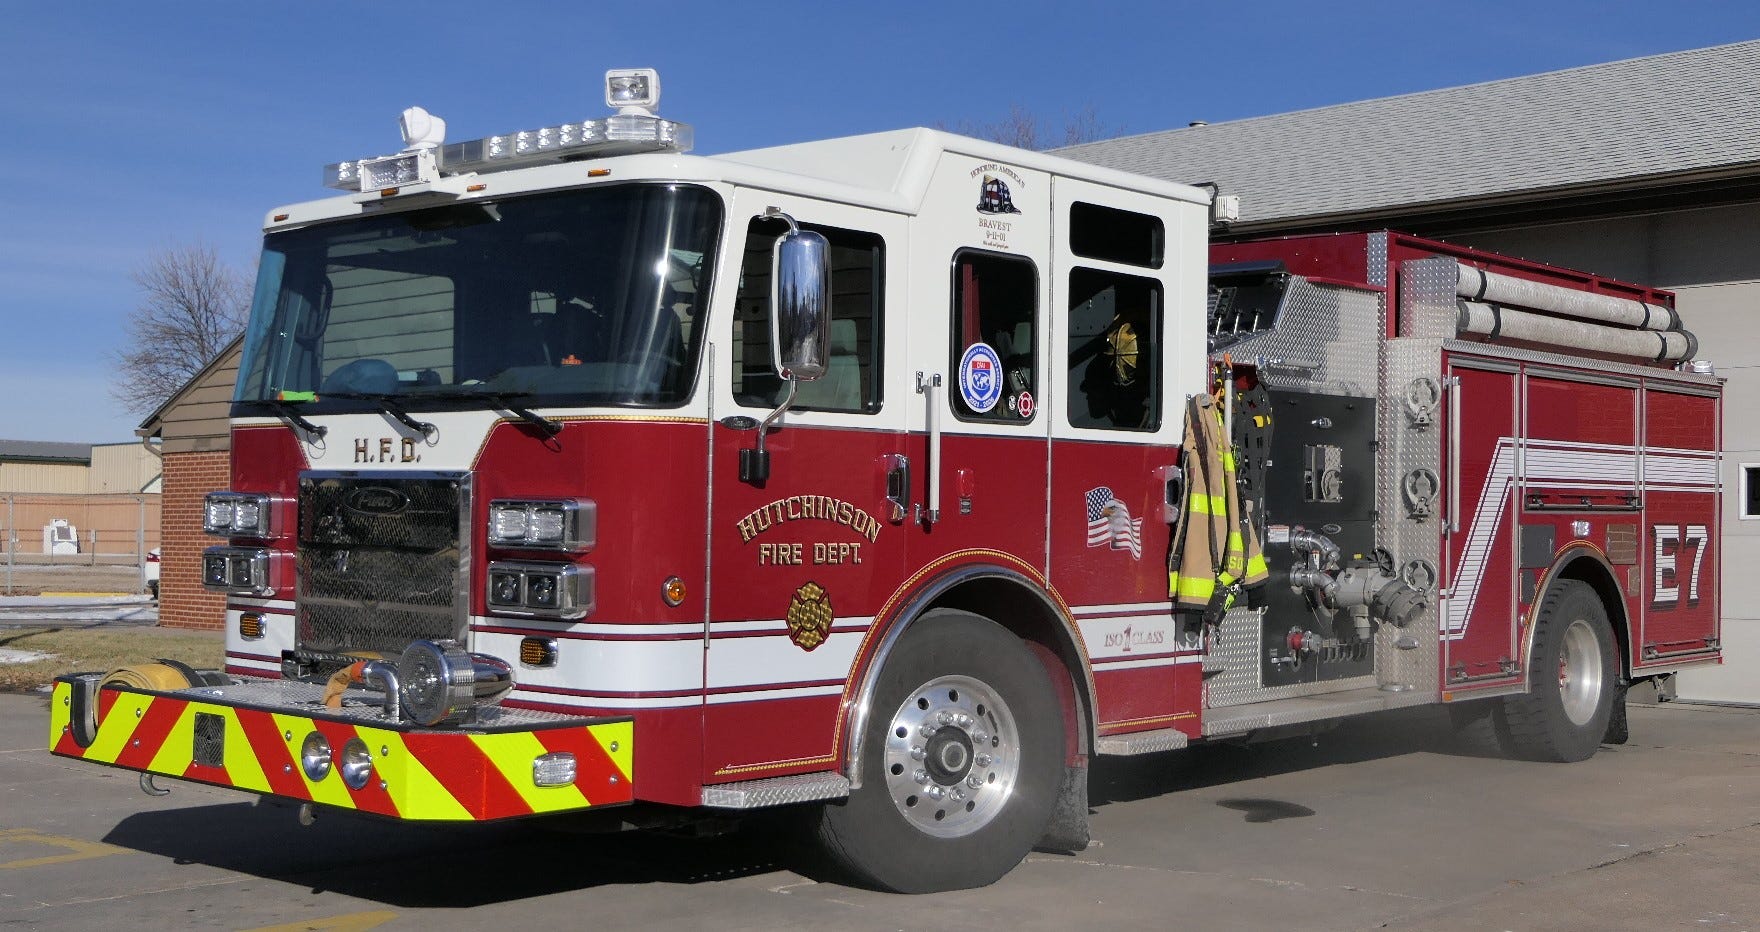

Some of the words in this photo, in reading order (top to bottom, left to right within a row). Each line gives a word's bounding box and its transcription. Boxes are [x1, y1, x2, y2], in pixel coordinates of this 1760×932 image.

[971, 164, 998, 178] HONORING
[979, 218, 1011, 231] BRAVEST
[986, 231, 1006, 241] 9-11-01
[354, 437, 422, 463] H.F.D.
[736, 494, 883, 544] HUTCHINSON
[758, 542, 804, 567] FIRE
[813, 541, 863, 565] DEPT.
[1652, 524, 1708, 603] E7
[1104, 632, 1122, 648] ISO
[1133, 630, 1165, 645] CLASS
